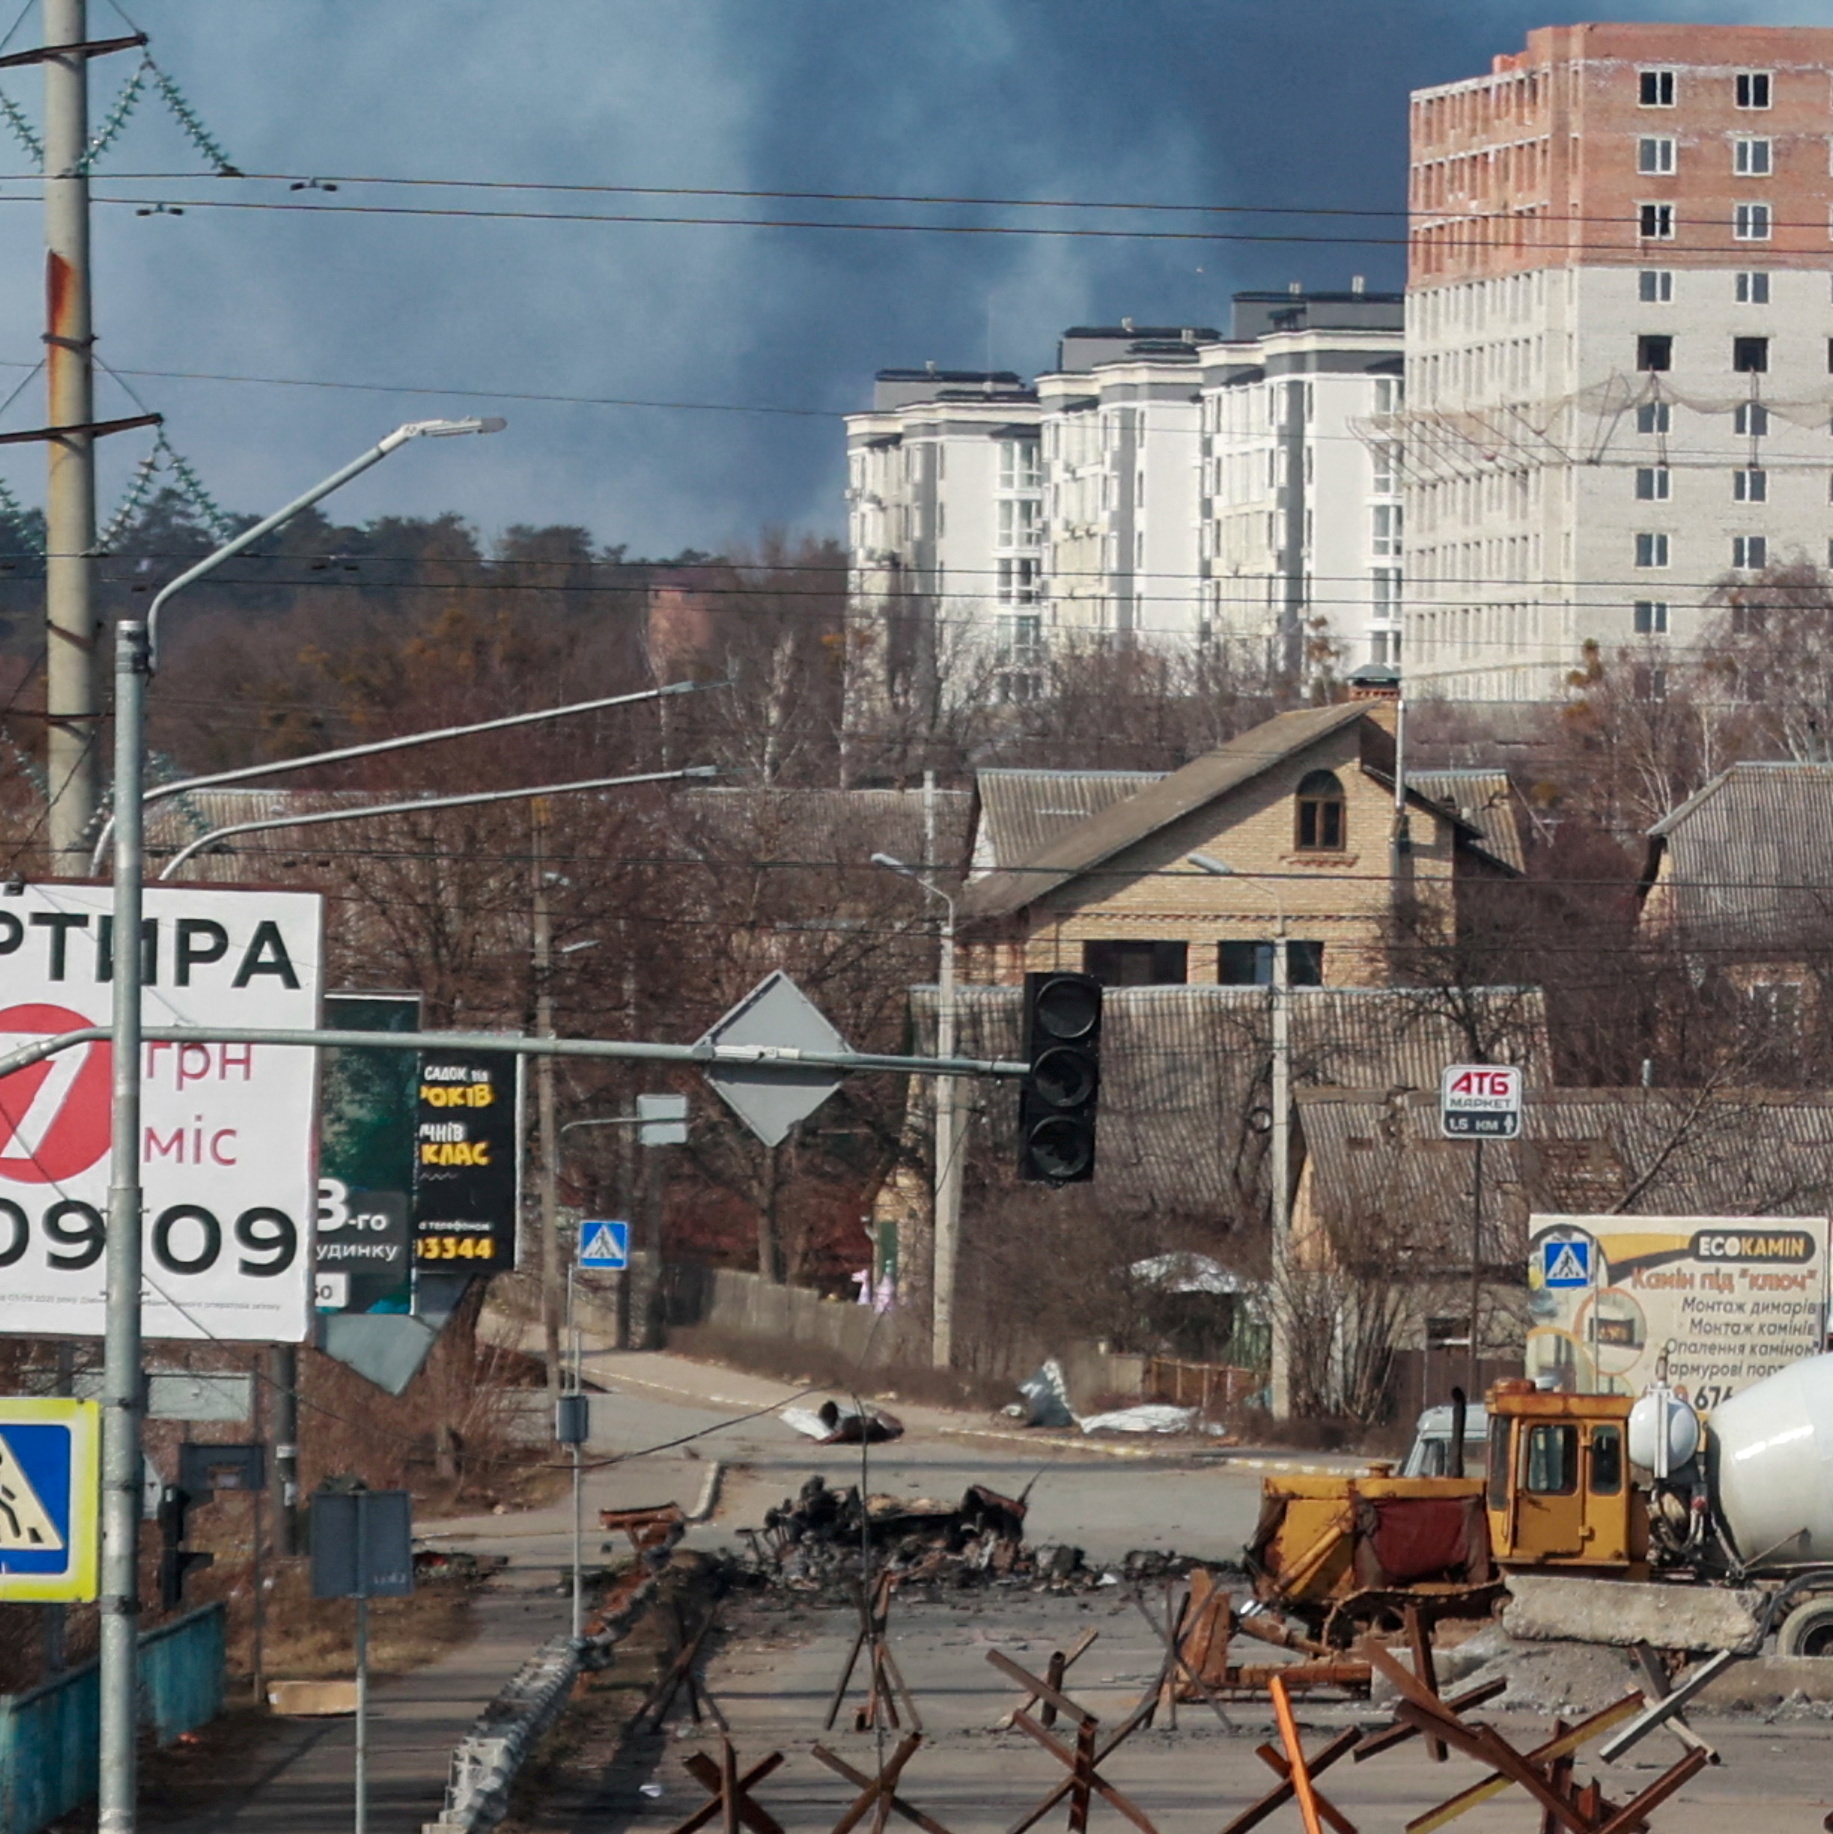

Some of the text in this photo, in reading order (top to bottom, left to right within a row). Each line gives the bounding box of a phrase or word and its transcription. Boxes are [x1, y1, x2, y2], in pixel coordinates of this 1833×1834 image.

[1451, 1072, 1511, 1096] АТБ
[1450, 1098, 1511, 1109] МАРКЕТ
[1475, 1120, 1499, 1131] КМ
[143, 1115, 238, 1166] міс
[421, 1143, 490, 1165] КЛАС
[152, 1204, 297, 1277] 09
[1700, 1237, 1805, 1257] ECOKAMIN
[316, 1244, 398, 1262] удинку
[1631, 1267, 1694, 1290] Камін
[1700, 1267, 1735, 1293] під
[1682, 1297, 1816, 1318] Монтаж димарів
[1689, 1319, 1816, 1336] Монтаж камінів
[1665, 1339, 1745, 1356] Опалення
[1669, 1361, 1743, 1379] армурові
